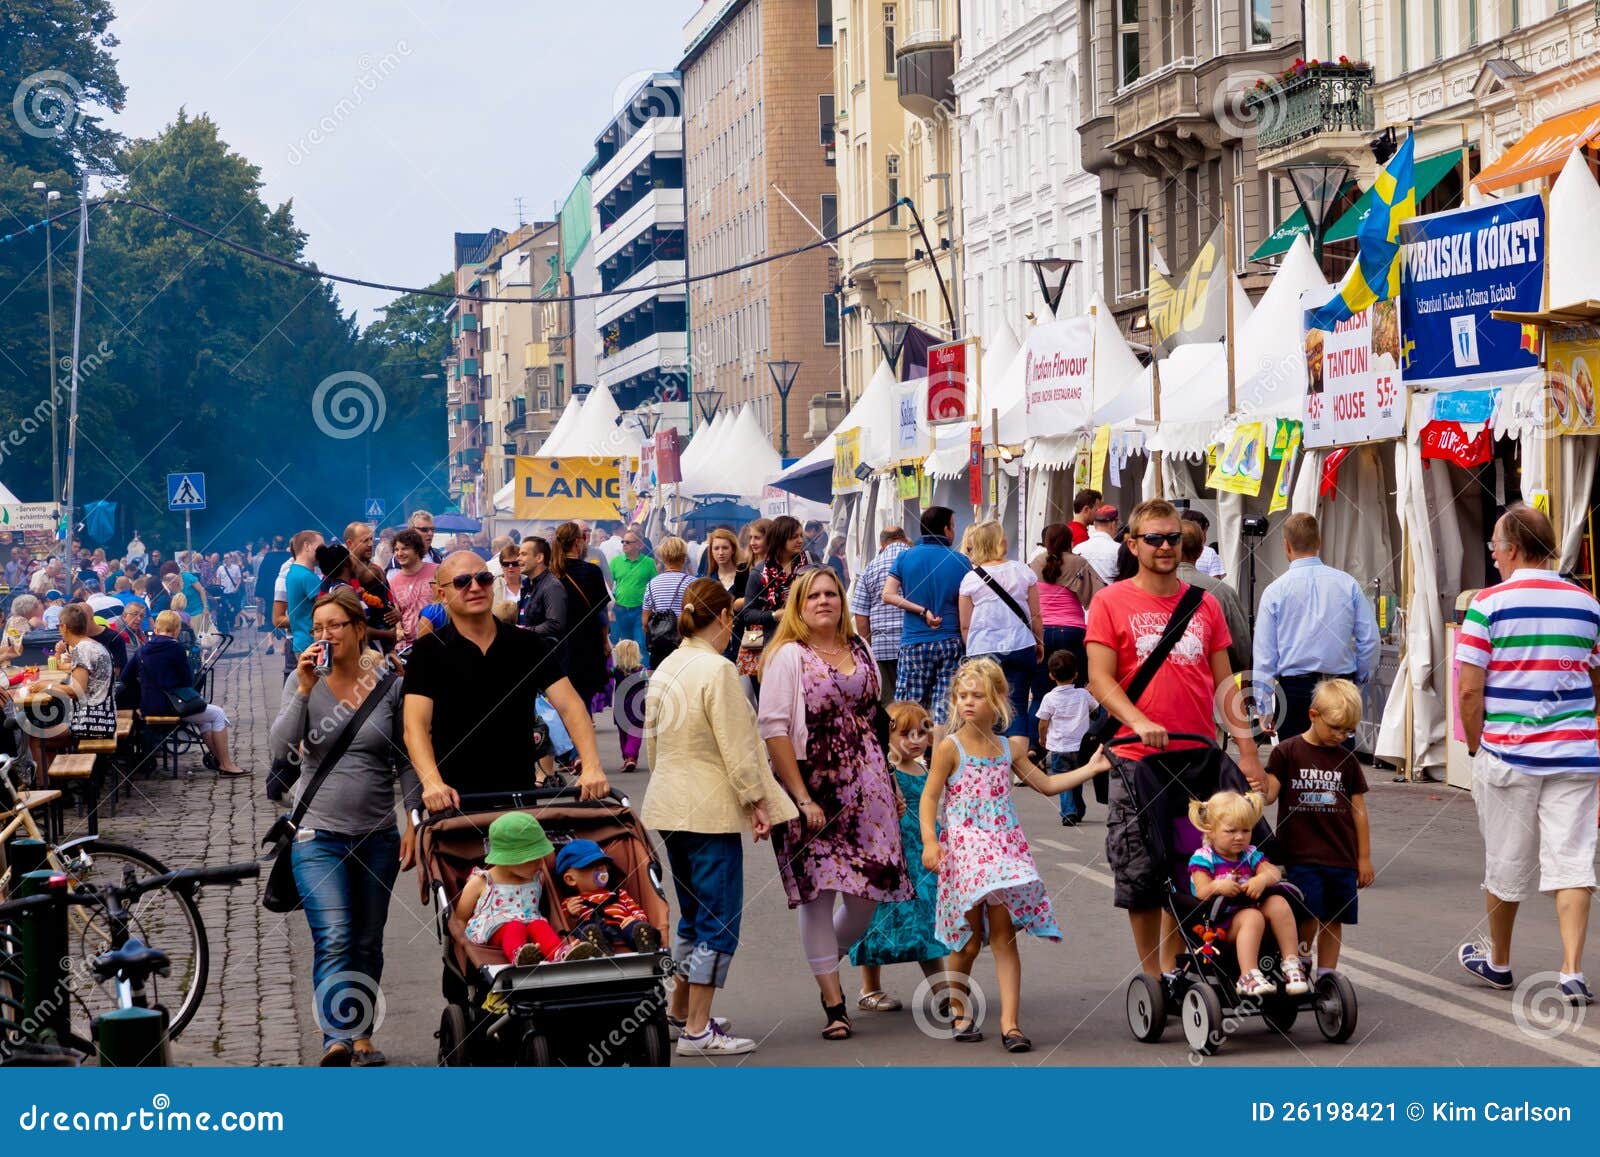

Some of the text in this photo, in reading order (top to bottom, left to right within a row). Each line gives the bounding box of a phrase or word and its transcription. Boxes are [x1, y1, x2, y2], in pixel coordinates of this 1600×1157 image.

[1476, 215, 1540, 271] KÖKET
[1442, 290, 1464, 312] Kebab
[1465, 288, 1489, 308] Adana
[1490, 281, 1517, 303] Kebab
[1052, 351, 1087, 378] Flavour
[1327, 345, 1368, 378] TANTUNI
[1333, 391, 1366, 421] HOUSE
[1376, 377, 1398, 408] 55:-
[1299, 768, 1342, 780] UNION
